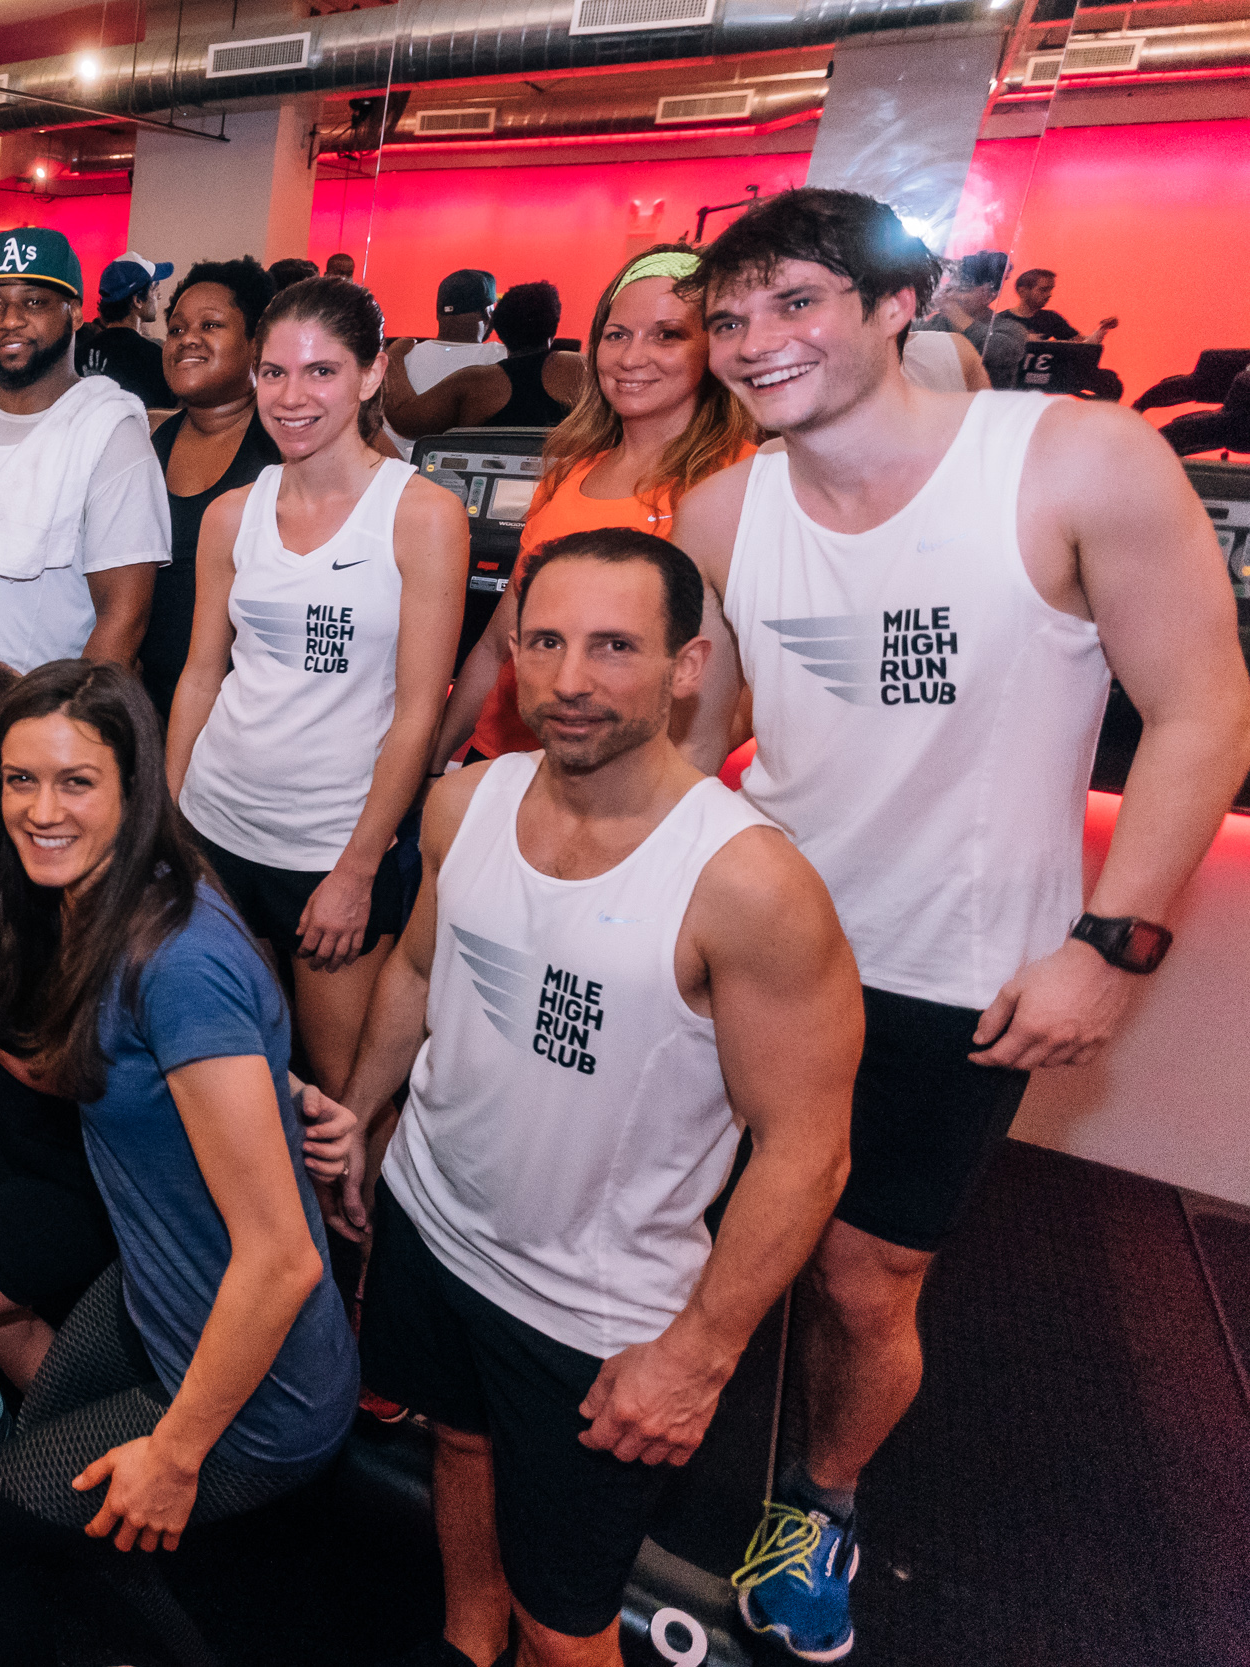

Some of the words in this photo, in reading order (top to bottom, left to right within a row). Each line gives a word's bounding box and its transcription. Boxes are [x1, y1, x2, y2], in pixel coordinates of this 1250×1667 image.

[306, 603, 353, 624] MILE
[883, 606, 951, 633] MILE
[306, 621, 355, 641] HIGH
[306, 637, 345, 658] RUN
[882, 632, 958, 658] HIGH
[304, 655, 349, 674] CLUB
[880, 657, 947, 682] RUN
[880, 681, 956, 706] CLUB
[543, 963, 604, 1006] MILE
[538, 986, 604, 1031] HIGH
[535, 1009, 590, 1050] RUN
[532, 1033, 597, 1076] CLUB
